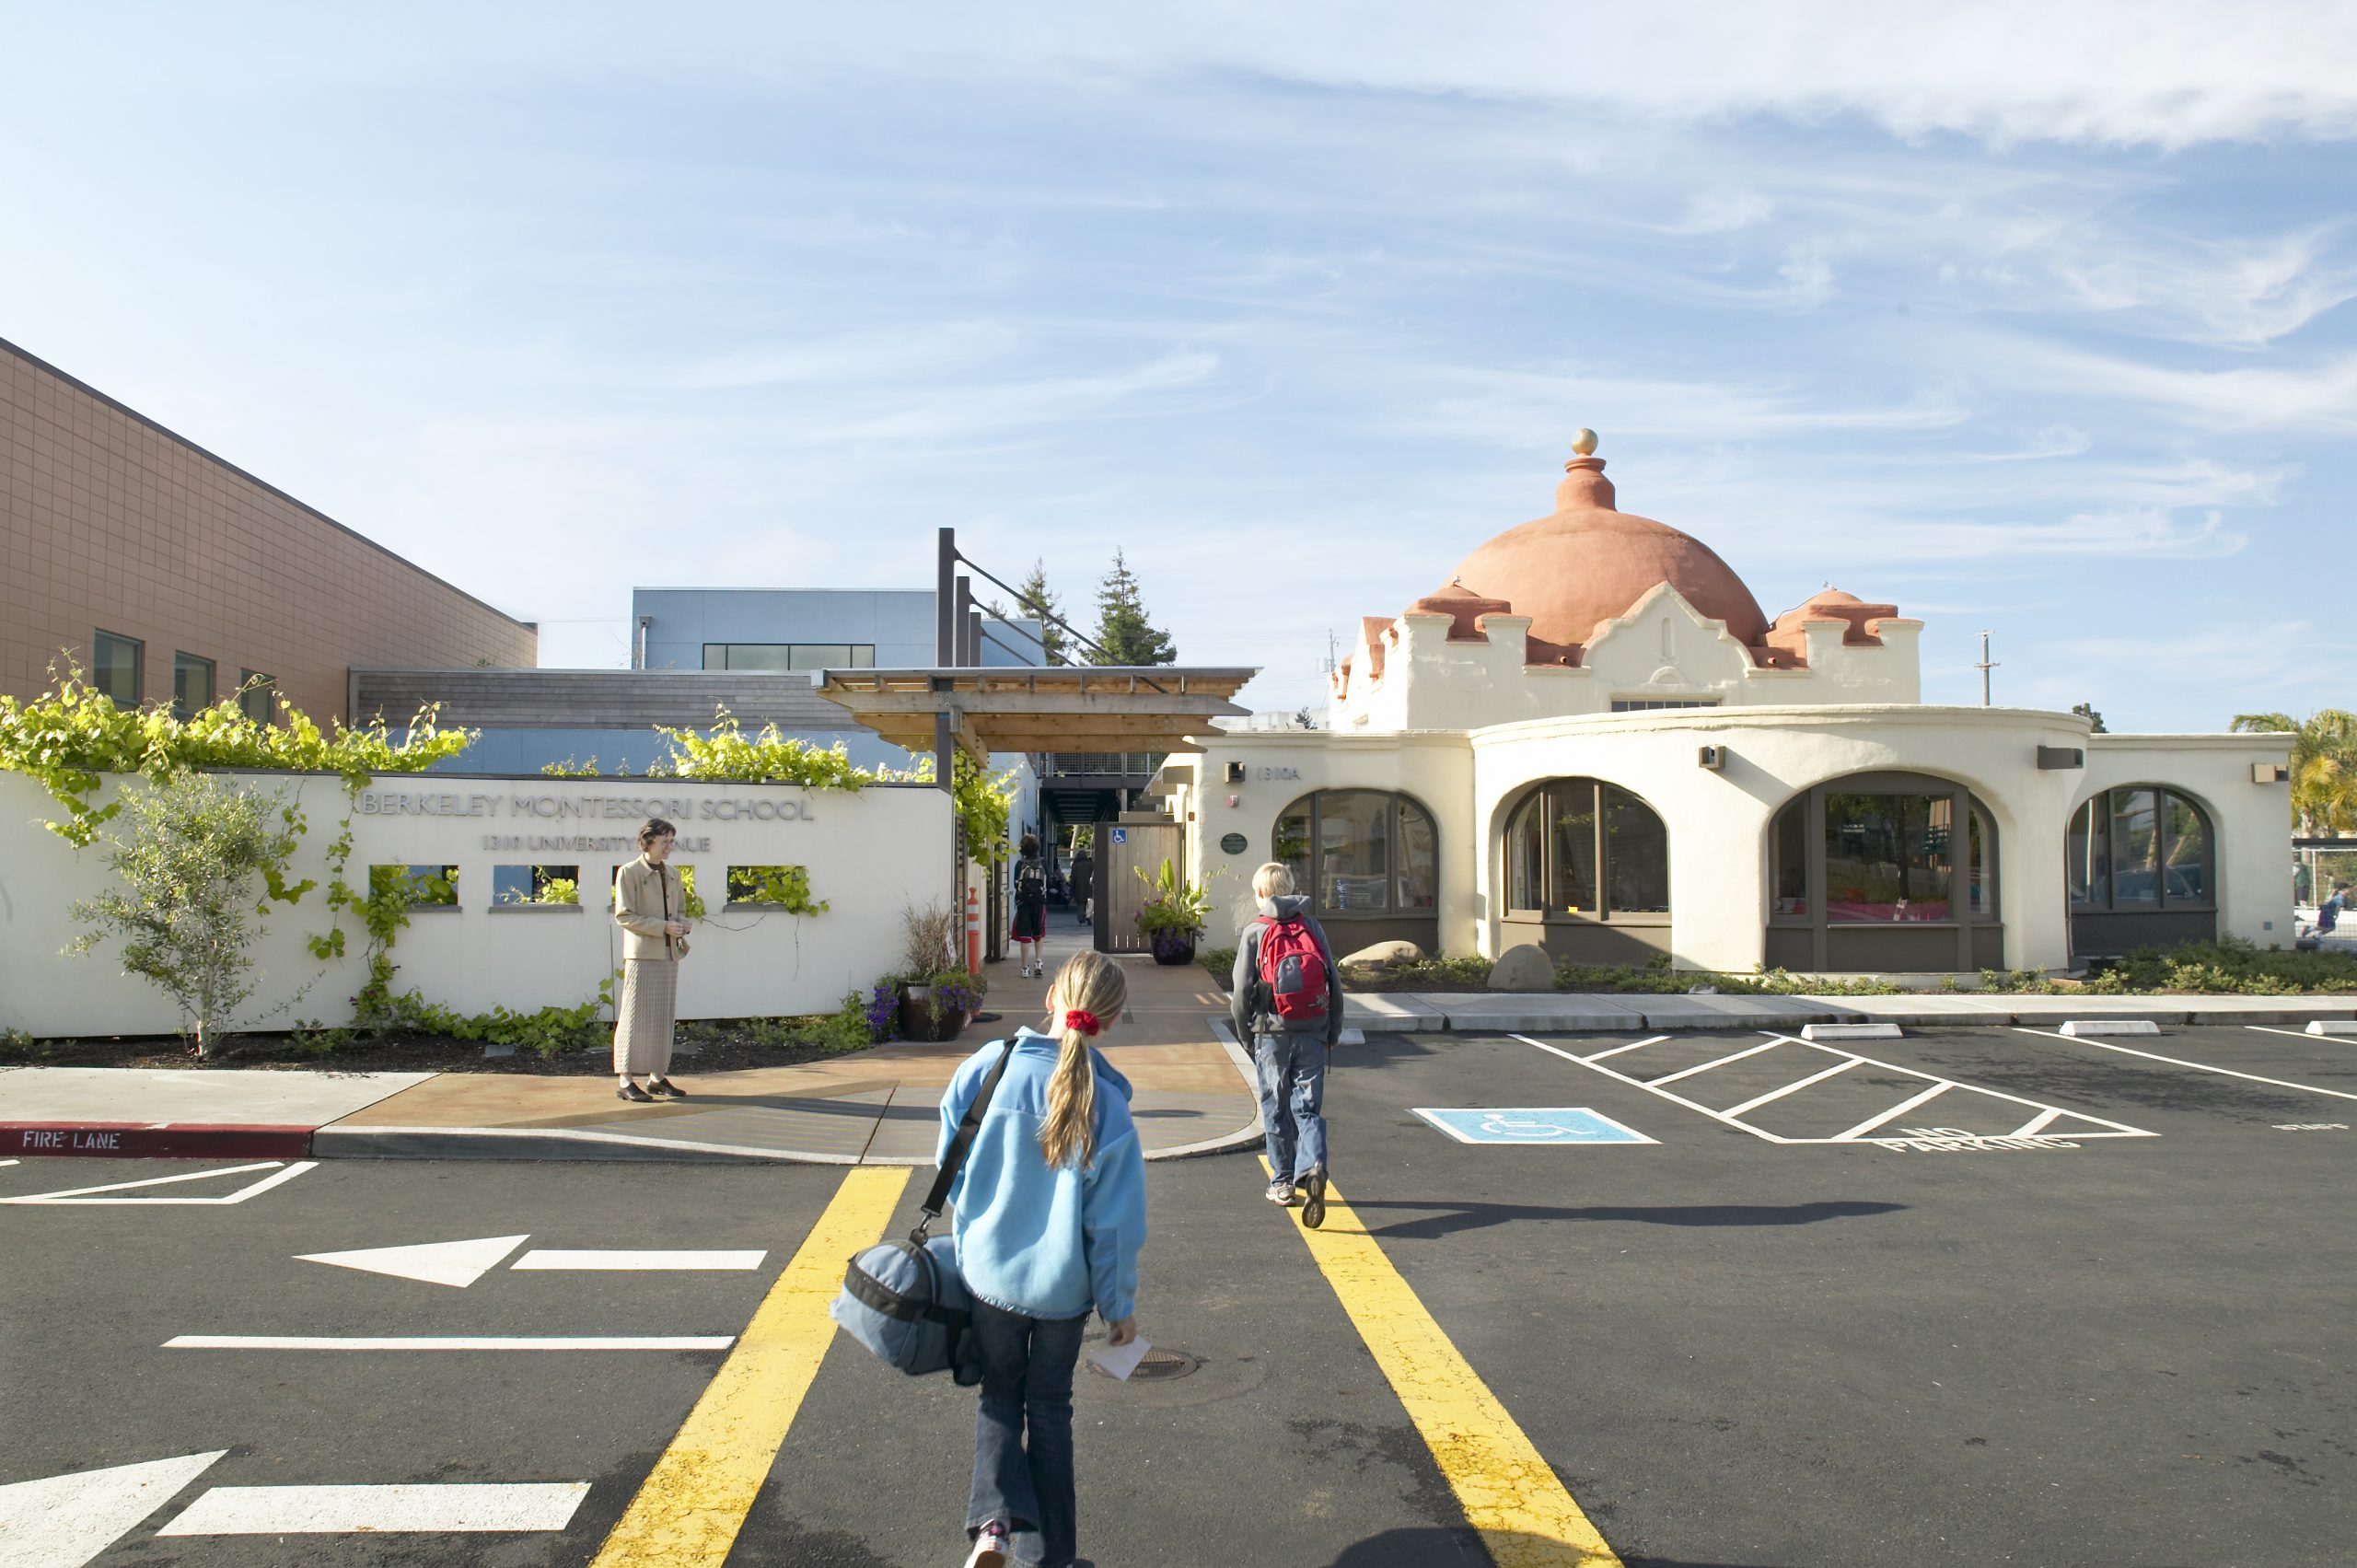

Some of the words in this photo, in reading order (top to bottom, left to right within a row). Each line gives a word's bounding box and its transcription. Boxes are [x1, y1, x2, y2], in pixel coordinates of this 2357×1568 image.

[362, 792, 503, 817] BERKELEY
[511, 795, 691, 819] MONTESSORI
[700, 798, 814, 820] SCHOOL
[482, 834, 522, 851] 1310
[527, 835, 636, 852] UNIVERSITY
[674, 837, 711, 853] NUE
[23, 1131, 64, 1148] FIRE
[73, 1132, 121, 1149] LANE
[1898, 1127, 1976, 1139] NO
[1872, 1137, 2081, 1153] PARKING
